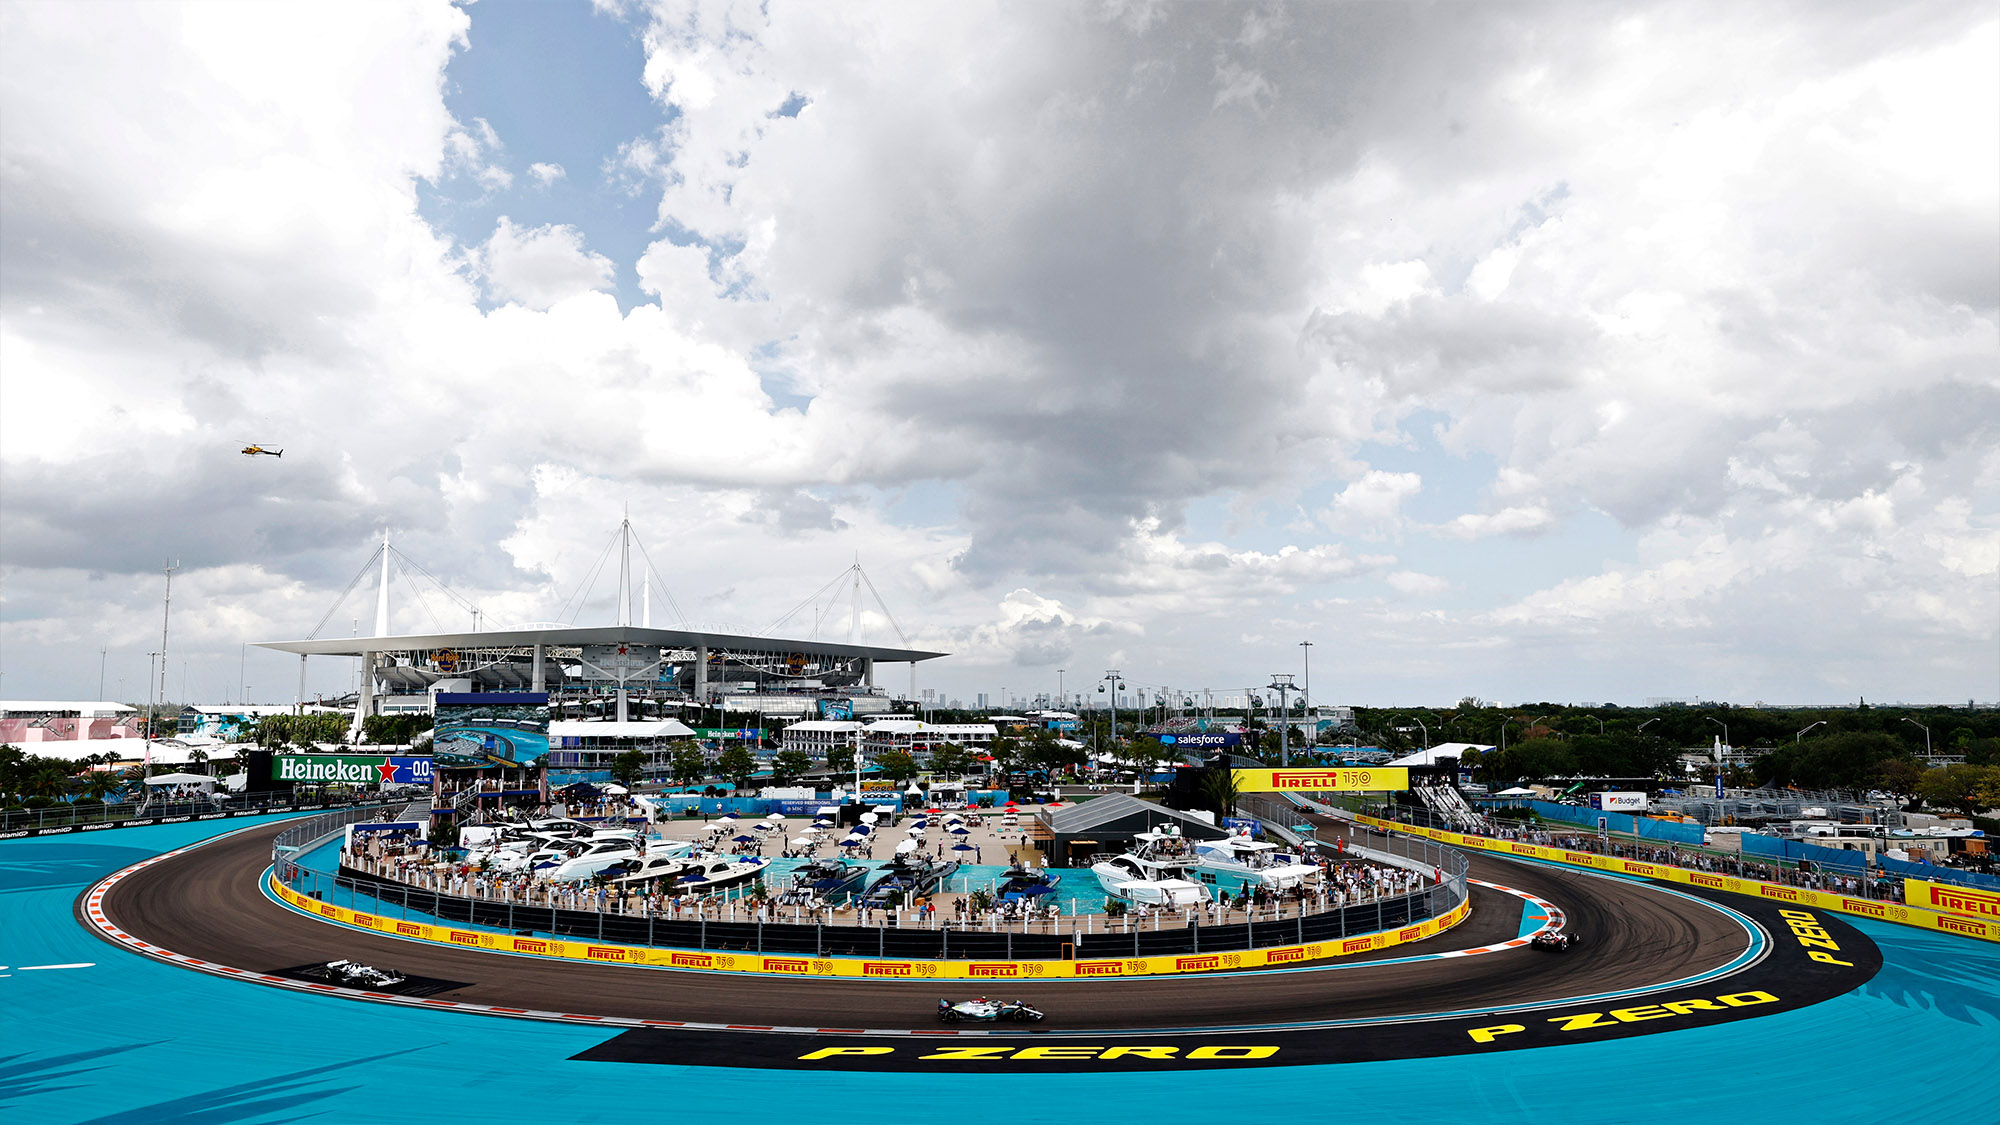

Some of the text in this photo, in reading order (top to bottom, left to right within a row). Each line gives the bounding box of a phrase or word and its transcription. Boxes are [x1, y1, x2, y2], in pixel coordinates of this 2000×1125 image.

[1178, 734, 1225, 747] salesforce
[279, 758, 373, 781] Heineken
[1272, 771, 1371, 788] PIRELLI 150
[1617, 796, 1641, 806] Budget
[82, 822, 114, 831] #MiamiGP
[123, 819, 153, 827] #MiamiGP
[161, 815, 190, 823] #MiamiGP
[38, 826, 72, 836] #MiamiGP
[1512, 844, 1536, 855] PIRELLI
[1565, 852, 1592, 865] PIRELLI
[1624, 862, 1654, 875] PIRELLI
[1690, 873, 1741, 890] PIRELLI 150
[1761, 885, 1817, 904] PIRELLI 150
[1842, 899, 1908, 920] PIRELLI 150
[354, 913, 373, 927] PIRELLI
[1937, 915, 1987, 936] PIRELLI
[396, 922, 420, 936] PIRELLI
[1400, 927, 1421, 941] PIRELLI
[450, 930, 494, 947] PIRELLI 150
[1778, 908, 1854, 967] P ZERO
[514, 939, 565, 955] PIRELLI 150
[1343, 938, 1371, 953] PIRELLI
[587, 946, 646, 962] PIRELLI 150
[671, 953, 735, 969] PIRELLI 150
[1267, 945, 1322, 963] PIRELLI 150
[763, 958, 833, 974] PIRELLI 150
[863, 962, 937, 976] PIRELLI 150
[968, 963, 1044, 976] PIRELLI 150
[1075, 960, 1148, 975] PIRELLI 150
[1176, 954, 1241, 970] PIRELLI 150
[1467, 990, 1781, 1043] P ZERO
[797, 1046, 1281, 1060] P ZERO
